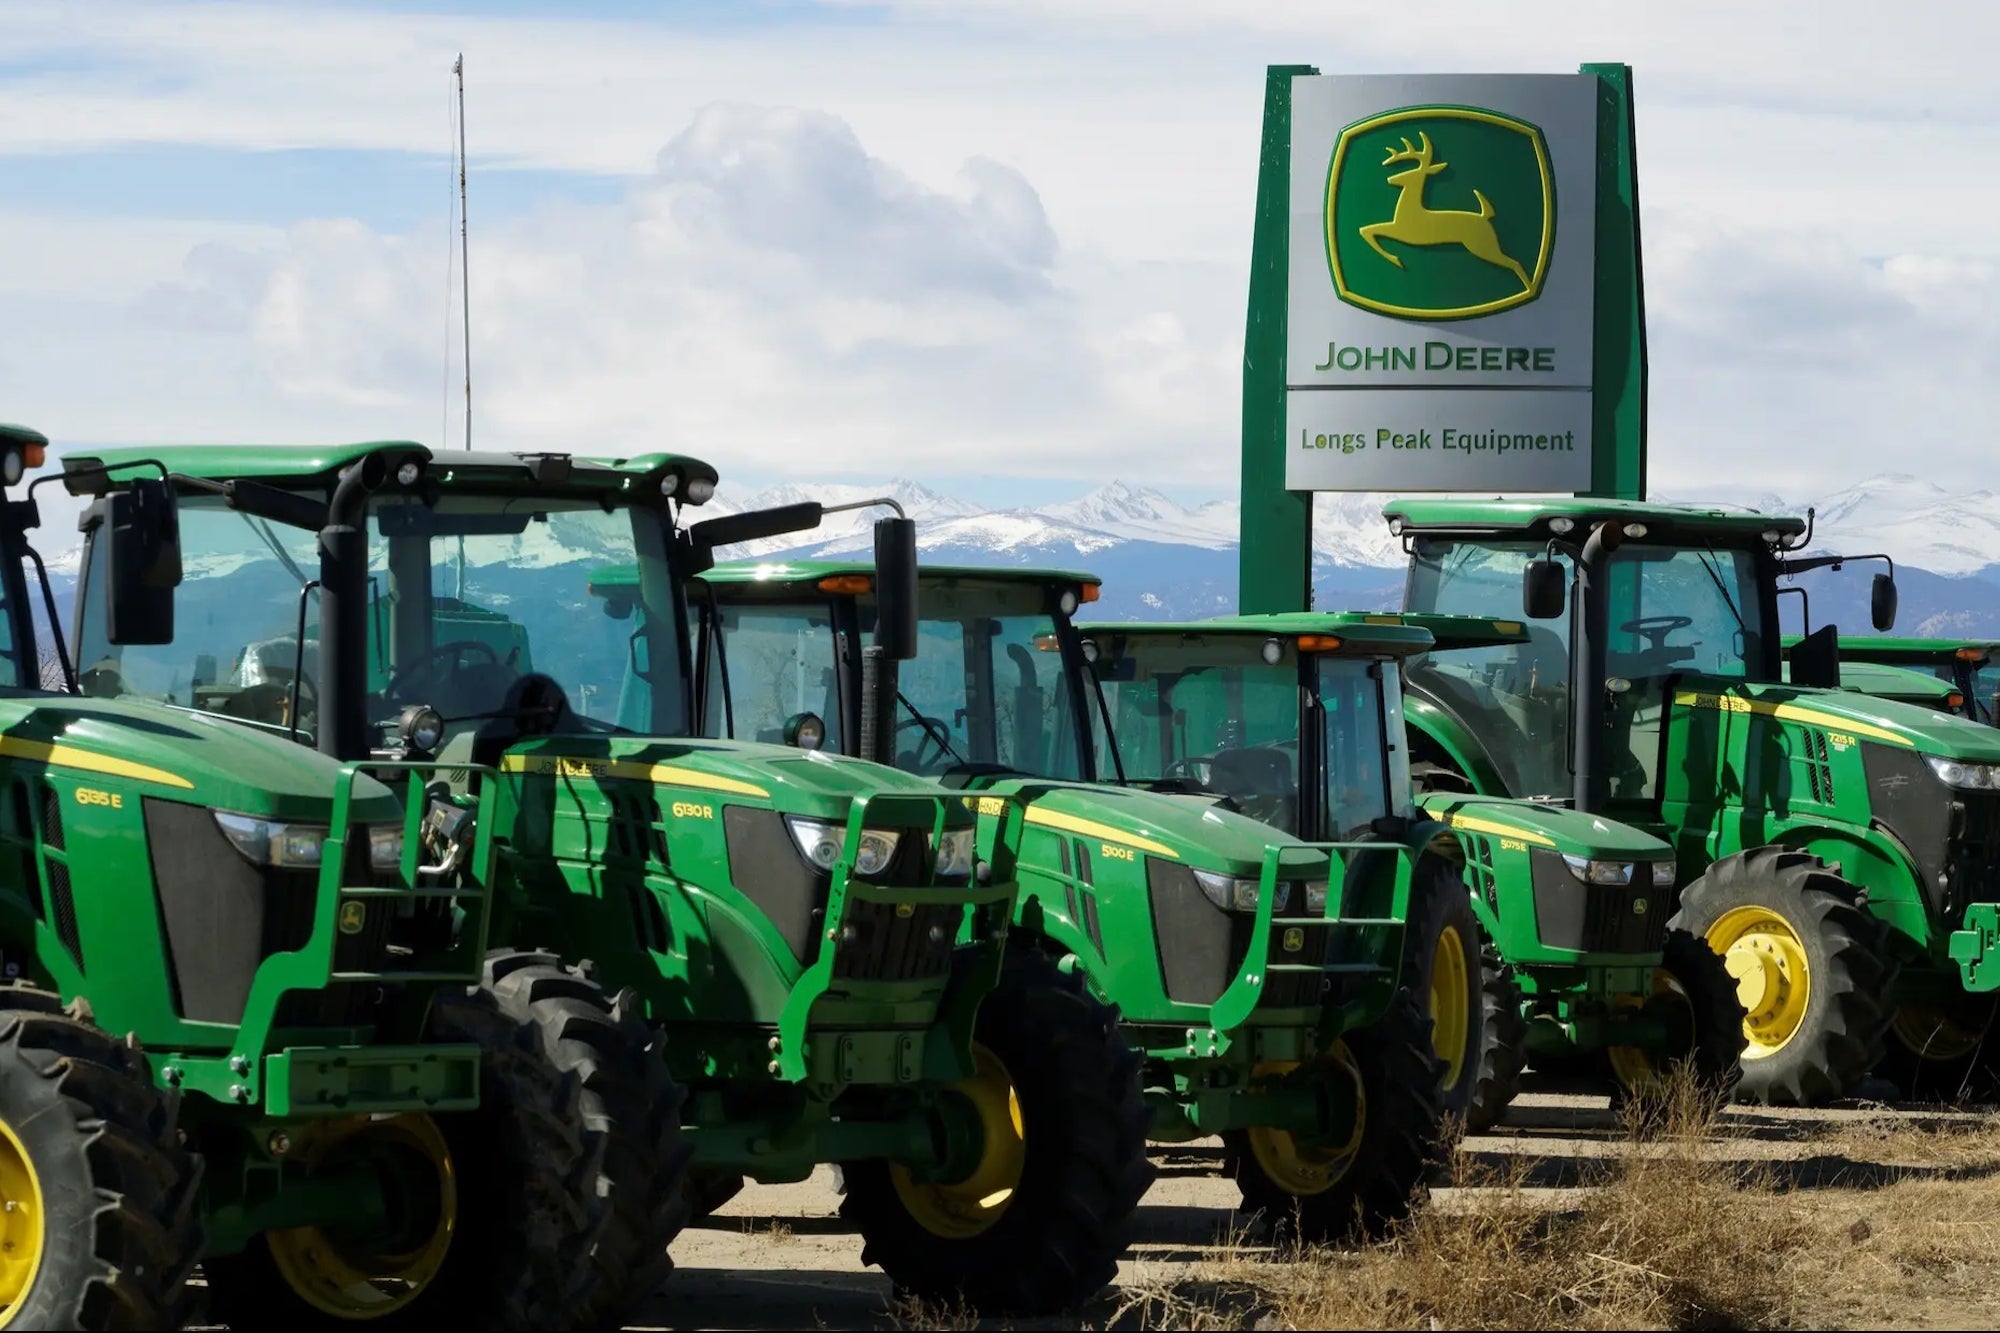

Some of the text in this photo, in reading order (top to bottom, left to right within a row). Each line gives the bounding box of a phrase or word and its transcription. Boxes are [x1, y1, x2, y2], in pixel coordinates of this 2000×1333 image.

[1315, 342, 1555, 372] JOHN DEERE
[1301, 428, 1574, 454] Longs Peak Equipment
